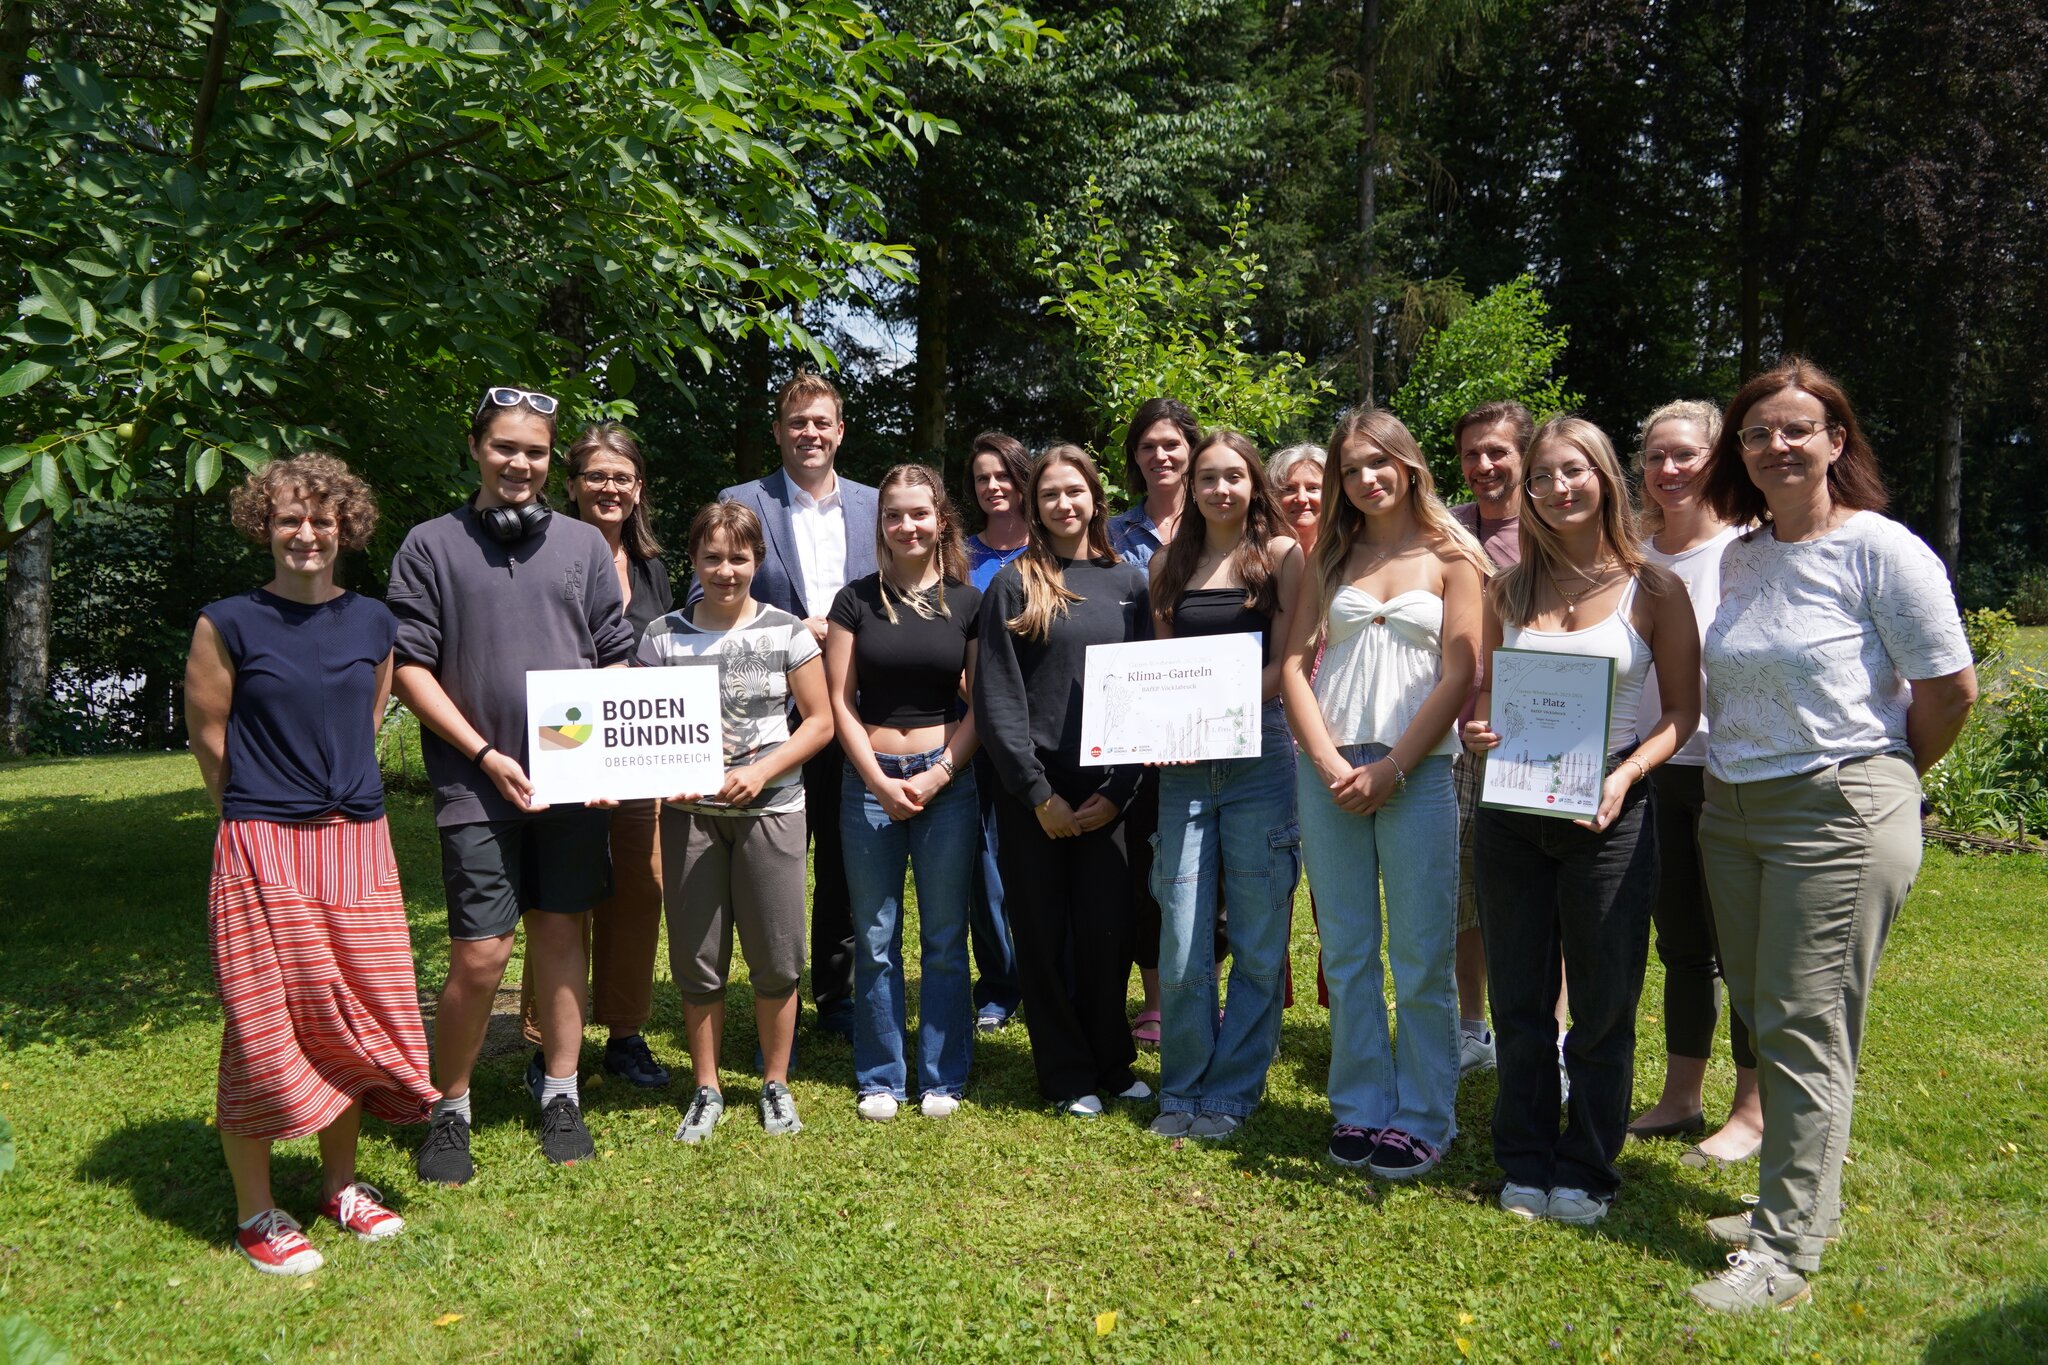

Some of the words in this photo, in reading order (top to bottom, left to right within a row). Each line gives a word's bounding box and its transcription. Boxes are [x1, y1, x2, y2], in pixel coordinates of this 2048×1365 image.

[1127, 666, 1212, 682] Klima-Garteln
[603, 698, 685, 721] BODEN
[1532, 698, 1539, 706] 1.
[1542, 697, 1566, 708] Platz
[604, 722, 710, 748] BÜNDNIS
[605, 753, 711, 768] OBERÖSTERREICH
